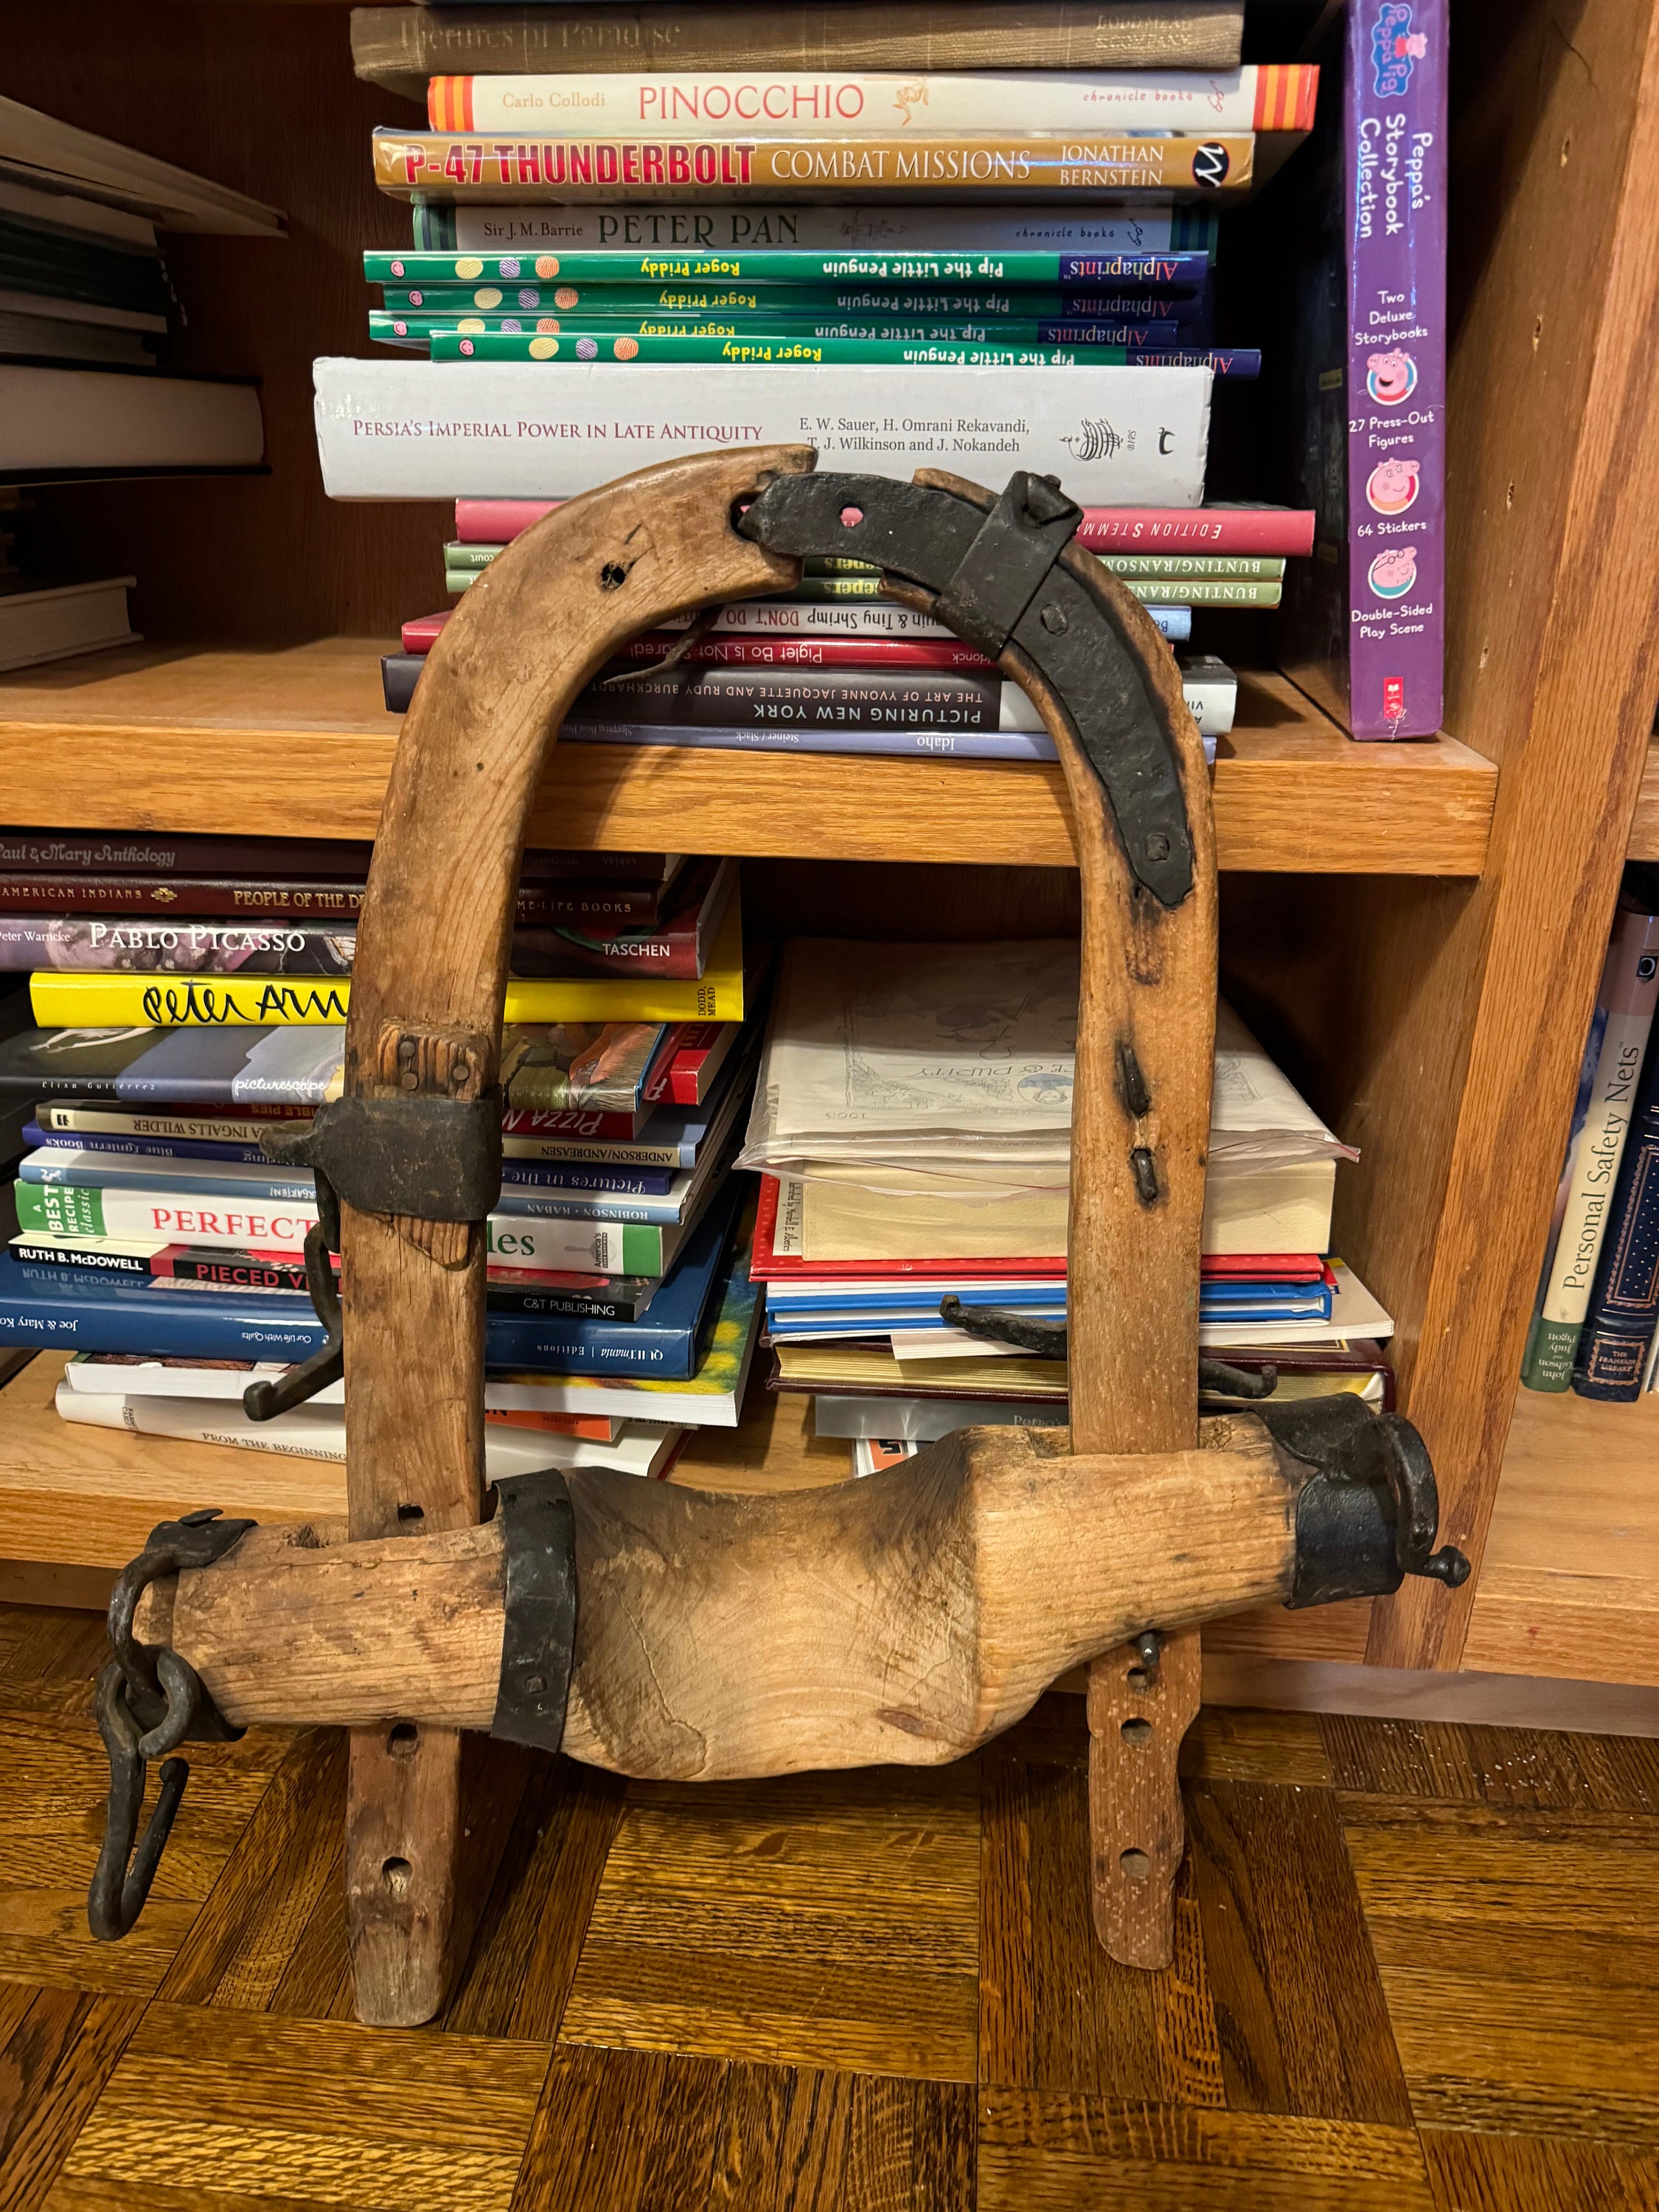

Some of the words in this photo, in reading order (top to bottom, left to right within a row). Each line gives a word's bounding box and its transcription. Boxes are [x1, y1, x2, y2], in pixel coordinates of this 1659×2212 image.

[1377, 7, 1408, 65] Peppa
[1381, 62, 1408, 92] Pig
[502, 93, 544, 108] Carlo
[549, 92, 606, 108] Collodi
[639, 84, 864, 120] PINOCCHIO
[1082, 89, 1147, 102] chronicle
[1155, 89, 1193, 101] books
[1060, 145, 1164, 163] JONATHAN
[405, 144, 485, 184] P-47
[493, 144, 757, 185] THUNDERBOLT
[771, 149, 891, 179] COMBAT
[895, 150, 1032, 180] MISSIONS
[1405, 132, 1433, 210] Peppa's
[1059, 169, 1163, 187] BERNSTEIN
[1359, 118, 1381, 239] Collection
[1380, 113, 1406, 236] Storybook
[484, 223, 504, 237] Sir
[507, 223, 517, 240] J.
[520, 223, 538, 237] M.
[540, 223, 584, 237] Barrie
[598, 215, 716, 247] PETER
[730, 215, 799, 246] PAN
[1015, 227, 1073, 239] chronicle
[1080, 227, 1116, 238] books
[640, 257, 690, 278] Priddy
[694, 259, 740, 276] Roger
[822, 258, 888, 277] Penguin
[891, 262, 939, 278] Little
[943, 262, 973, 279] the
[978, 257, 1004, 278] Pip
[1070, 257, 1178, 281] Alphaprints
[1377, 290, 1405, 305] Two
[1368, 310, 1413, 325] Deluxe
[1354, 325, 1428, 346] Storybooks
[722, 341, 772, 362] Priddy
[776, 344, 822, 362] Roger
[903, 347, 965, 365] Penguin
[970, 351, 1014, 366] Little
[1019, 352, 1046, 366] the
[1051, 349, 1075, 366] Pip
[799, 418, 812, 431] E.
[815, 418, 833, 431] W.
[838, 418, 879, 434] Sauer,
[883, 418, 898, 431] H.
[902, 418, 953, 432] Omrani
[956, 418, 1030, 435] Rekavandi,
[1349, 418, 1366, 433] 27
[1368, 411, 1435, 430] Press-Out
[352, 419, 422, 437] PERSIA'S
[428, 421, 512, 438] IMPERIAL
[516, 421, 581, 439] POWER
[613, 422, 655, 439] LATE
[660, 423, 763, 443] ANTIQUITY
[823, 437, 835, 452] J.
[839, 436, 905, 451] Wilkinson
[909, 437, 933, 451] and
[936, 437, 949, 453] J.
[952, 437, 1020, 452] Nokandeh
[1368, 434, 1414, 451] Figures
[1077, 522, 1144, 538] STEMM
[1150, 523, 1222, 539] EDITION
[1357, 524, 1373, 538] 64
[1377, 520, 1427, 535] Stickers
[1103, 560, 1262, 573] BUNTING/RANSOM
[726, 609, 746, 625] DO
[756, 608, 799, 626] DON'T
[807, 608, 858, 629] Shrimp
[863, 610, 894, 630] Tiny
[897, 614, 908, 628] &
[1351, 602, 1433, 623] Double-Sided
[1360, 625, 1385, 640] Play
[1390, 622, 1425, 636] Scene
[698, 645, 728, 661] Not
[734, 646, 745, 661] Is
[751, 647, 773, 661] Bo
[780, 644, 822, 664] Piglet
[686, 685, 720, 695] RUDY
[726, 686, 754, 697] AND
[759, 686, 836, 700] JACQUETTE
[841, 689, 897, 700] YVONNE
[902, 691, 919, 701] OF
[925, 692, 951, 703] ART
[956, 692, 983, 703] THE
[753, 704, 807, 719] YORK
[816, 706, 860, 720] NEW
[870, 707, 981, 724] PICTURING
[736, 731, 759, 742] Slack
[768, 732, 799, 743] Steiner
[917, 737, 956, 751] Idaho
[94, 844, 176, 868] Anthology
[1, 887, 76, 898] AMERICAN
[82, 888, 142, 900] INDIANS
[233, 890, 291, 906] PEOPLE
[293, 892, 313, 908] OF
[315, 893, 345, 908] THE
[581, 902, 633, 913] BOOKS
[24, 931, 72, 942] Warncke
[88, 922, 178, 950] PABLO
[188, 923, 306, 953] PICASSO
[602, 943, 671, 957] TASCHEN
[698, 985, 708, 1016] DODD,
[707, 987, 716, 1016] MEAD
[1604, 1046, 1640, 1105] Nets
[41, 1080, 77, 1090] Elisa
[87, 1080, 156, 1091] Gutiérrez
[234, 1077, 327, 1094] picturescape
[133, 1119, 187, 1134] WILDER
[189, 1121, 248, 1138] INGALLS
[530, 1109, 604, 1136] PIZZA
[45, 1138, 85, 1148] Books
[1587, 1111, 1630, 1186] Safety
[541, 1145, 674, 1163] ANDERSON/ANDREASEN
[511, 1171, 538, 1184] the
[544, 1174, 563, 1186] in
[571, 1174, 647, 1194] Pictures
[44, 1184, 65, 1232] BEST
[63, 1186, 80, 1234] RECIPE
[78, 1188, 95, 1234] classic
[526, 1203, 571, 1215] KABAN
[582, 1207, 649, 1221] ROBINSON
[151, 1207, 319, 1240] PERFECT
[487, 1220, 536, 1256] les
[593, 1232, 602, 1267] America's
[1561, 1192, 1607, 1291] Personal
[18, 1248, 55, 1263] RUTH
[58, 1251, 69, 1264] B.
[71, 1253, 144, 1271] McDOWELL
[195, 1263, 280, 1287] PIECED
[524, 1298, 547, 1310] C&T
[549, 1300, 616, 1317] PUBLISHING
[18, 1315, 45, 1329] Mary
[47, 1318, 58, 1329] &
[58, 1318, 79, 1331] Joe
[241, 1332, 264, 1342] Quilts
[265, 1333, 282, 1343] With
[283, 1334, 296, 1343] Life
[296, 1335, 312, 1343] Our
[1547, 1332, 1576, 1343] Pigott
[537, 1345, 585, 1357] Editions
[1548, 1342, 1571, 1354] Judy
[1538, 1359, 1573, 1370] Gibson
[1542, 1370, 1565, 1380] John
[201, 1431, 240, 1445] FROM
[242, 1438, 271, 1450] THE
[272, 1443, 347, 1461] BEGINNING
